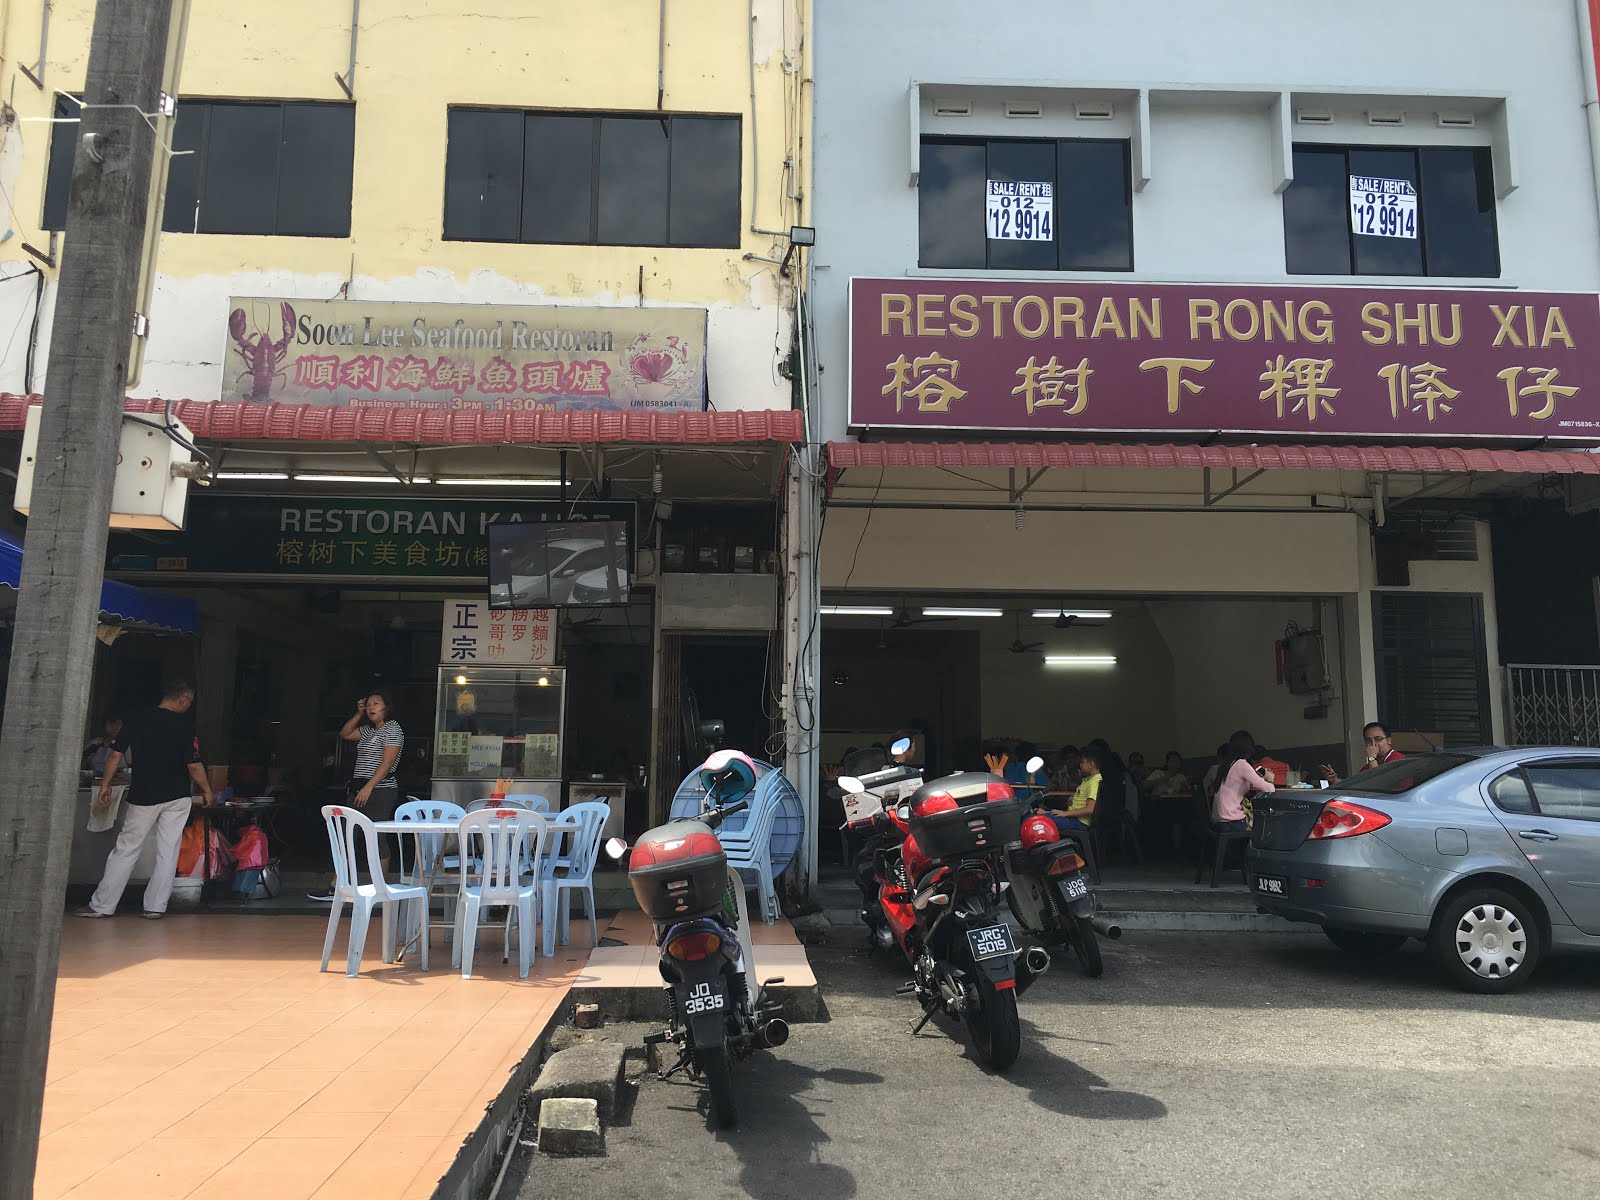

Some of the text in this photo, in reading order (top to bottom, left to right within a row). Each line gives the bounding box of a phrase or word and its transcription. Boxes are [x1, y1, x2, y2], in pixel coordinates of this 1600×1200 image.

[993, 182, 1041, 196] SALE/RENT
[1358, 178, 1405, 194] SALE/RENT
[1000, 196, 1034, 209] 012
[1365, 193, 1399, 206] 012
[1015, 209, 1051, 239] 9914
[1379, 205, 1415, 237] 9914
[881, 293, 1576, 349] RESTORAN RONG SHU XIA
[297, 315, 615, 353] Soon Lee Seafood Restoran
[882, 351, 1580, 423] 榕樹下粿條仔
[349, 398, 406, 408] Business
[451, 397, 482, 410] 3PM
[495, 398, 556, 412] 1:30AM
[280, 508, 466, 535] RESTORAN
[451, 603, 478, 660] 正宗
[977, 927, 1003, 944] JRG
[977, 938, 1008, 956] 5019
[685, 994, 725, 1015] 3535
